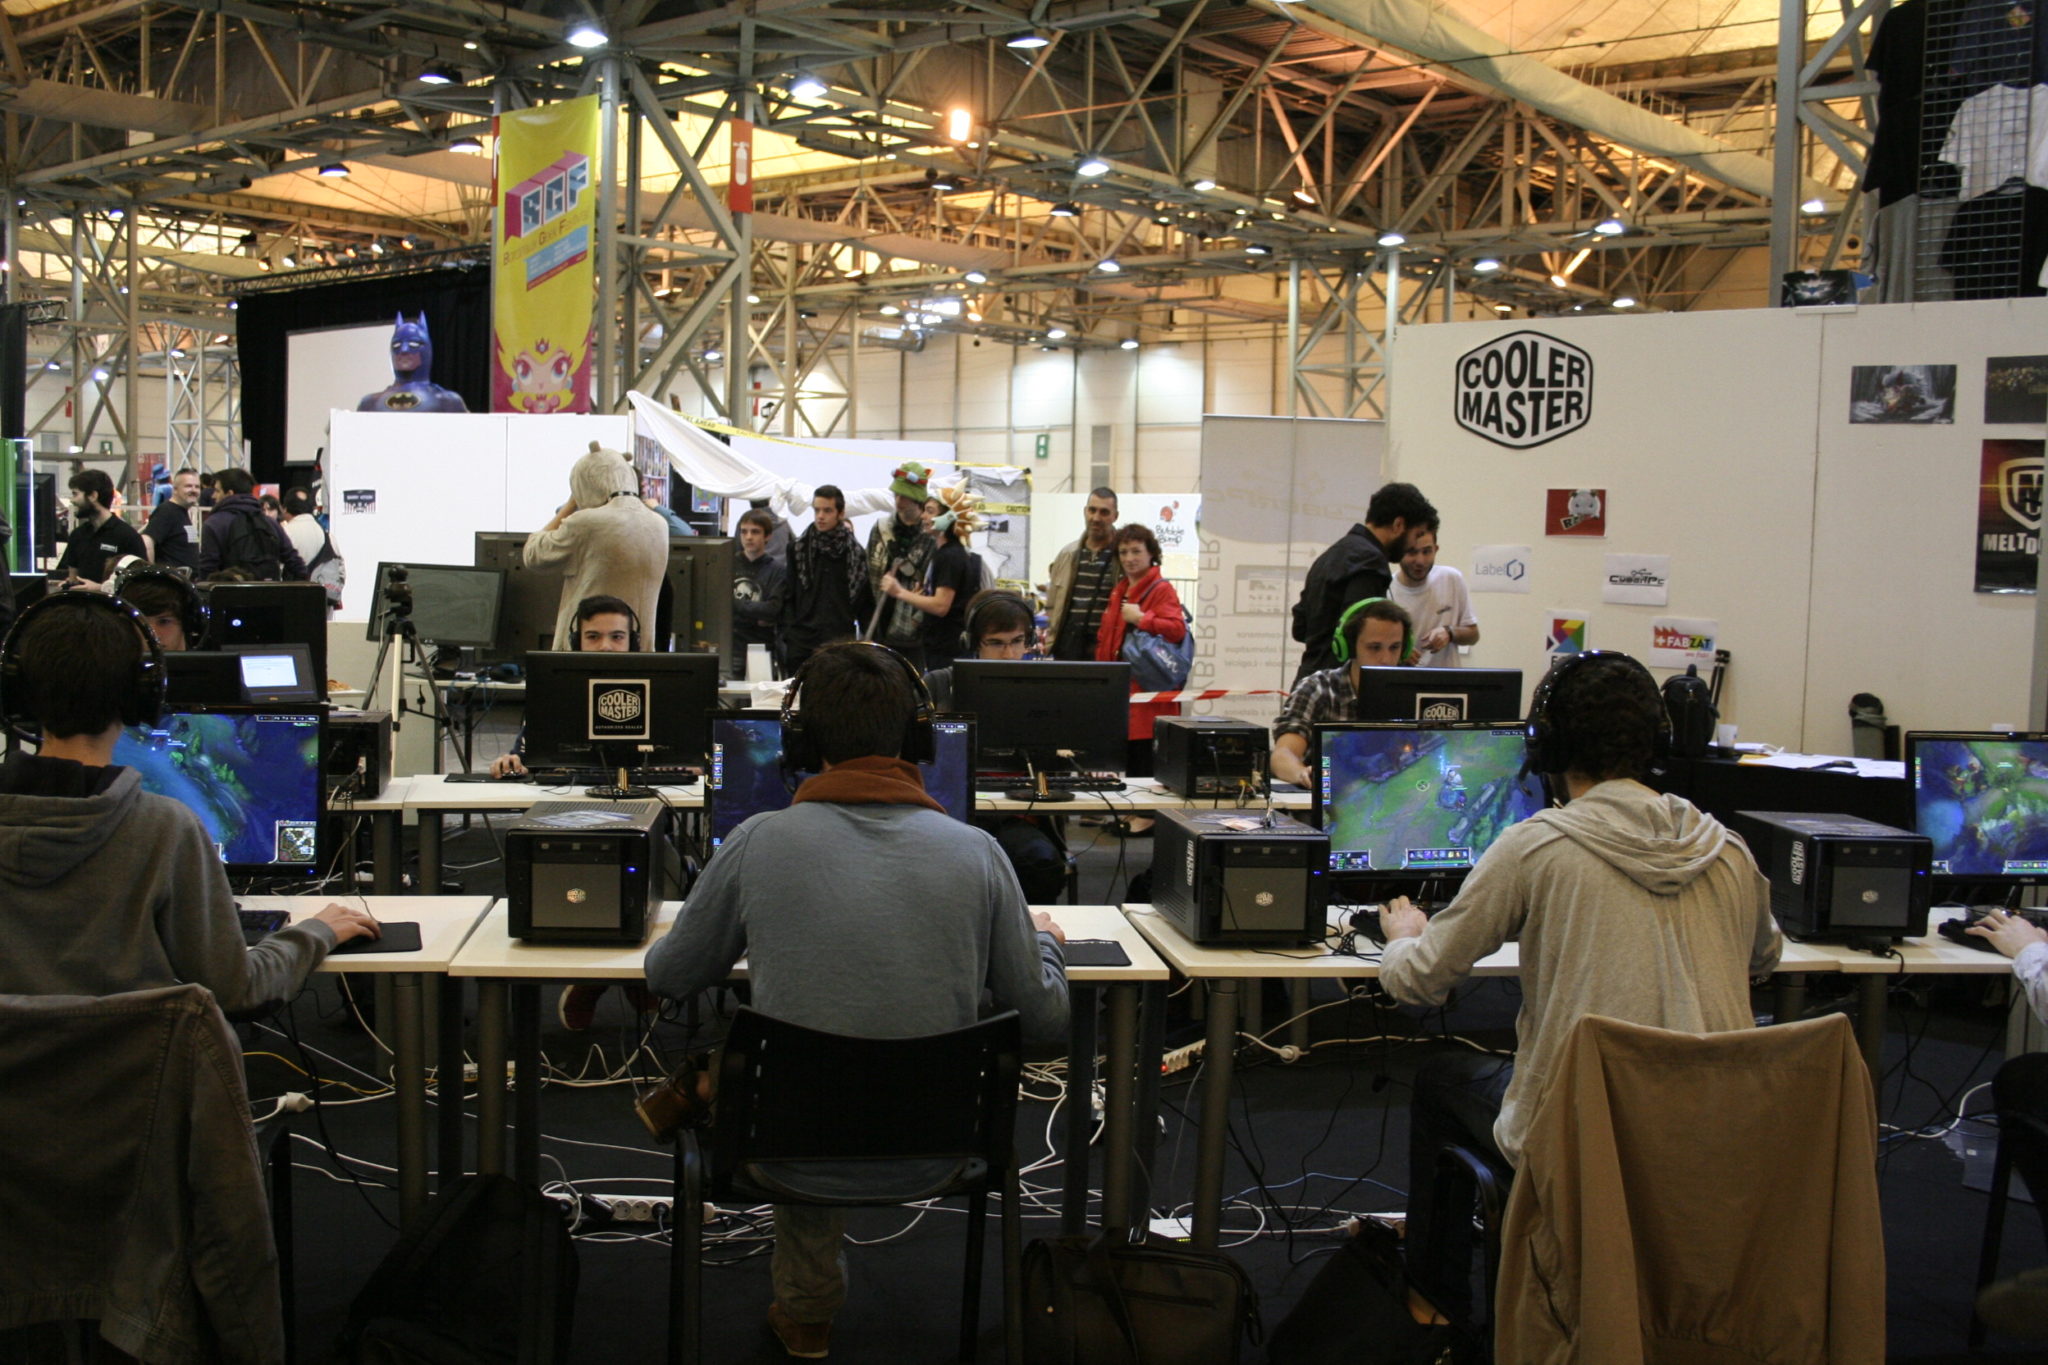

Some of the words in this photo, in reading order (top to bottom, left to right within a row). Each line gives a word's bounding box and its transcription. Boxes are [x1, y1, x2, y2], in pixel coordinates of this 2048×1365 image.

[1463, 340, 1585, 389] COOLER
[1462, 391, 1583, 439] MASTER
[1006, 505, 1031, 514] CAUTION
[1982, 532, 2042, 555] MELTD
[601, 692, 638, 706] COOLER
[600, 706, 638, 719] MASTER
[1425, 705, 1457, 718] COOLER
